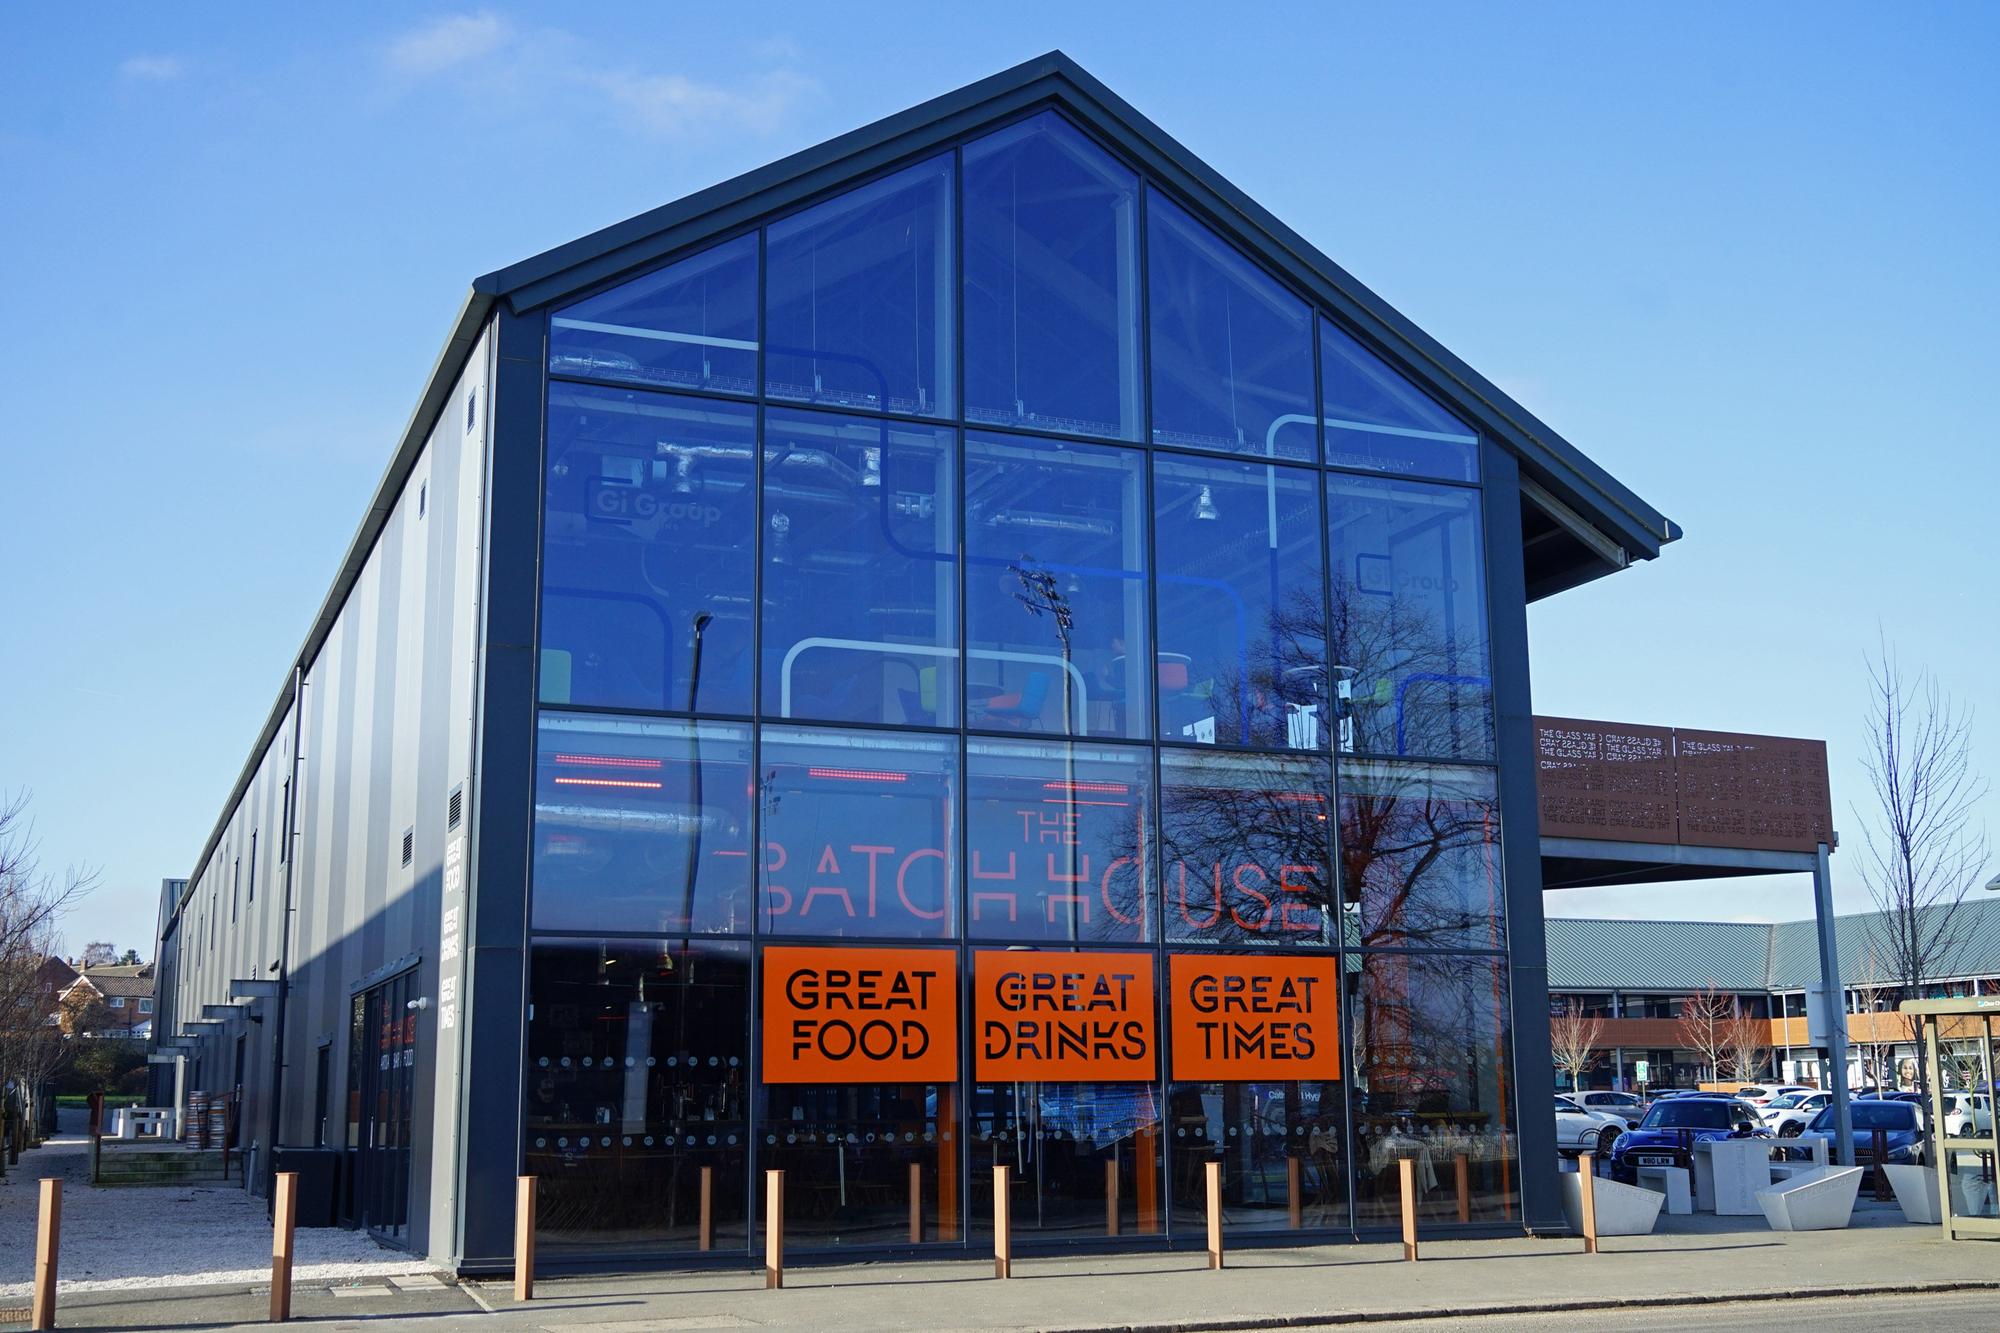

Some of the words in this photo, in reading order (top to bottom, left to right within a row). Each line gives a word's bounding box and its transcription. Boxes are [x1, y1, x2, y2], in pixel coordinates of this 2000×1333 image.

[1539, 728, 1554, 739] THE
[1555, 730, 1581, 741] GLASS
[1556, 748, 1582, 759] GLASS
[1017, 810, 1082, 845] THE
[758, 842, 1017, 922] BATCH
[1047, 853, 1322, 932] HOUSE
[786, 968, 937, 1011] GREAT
[995, 972, 1136, 1013] GREAT
[1189, 974, 1319, 1014] GREAT
[792, 1019, 930, 1061] FOOD
[985, 1020, 1146, 1061] DRINKS
[1196, 1020, 1317, 1061] TIMES
